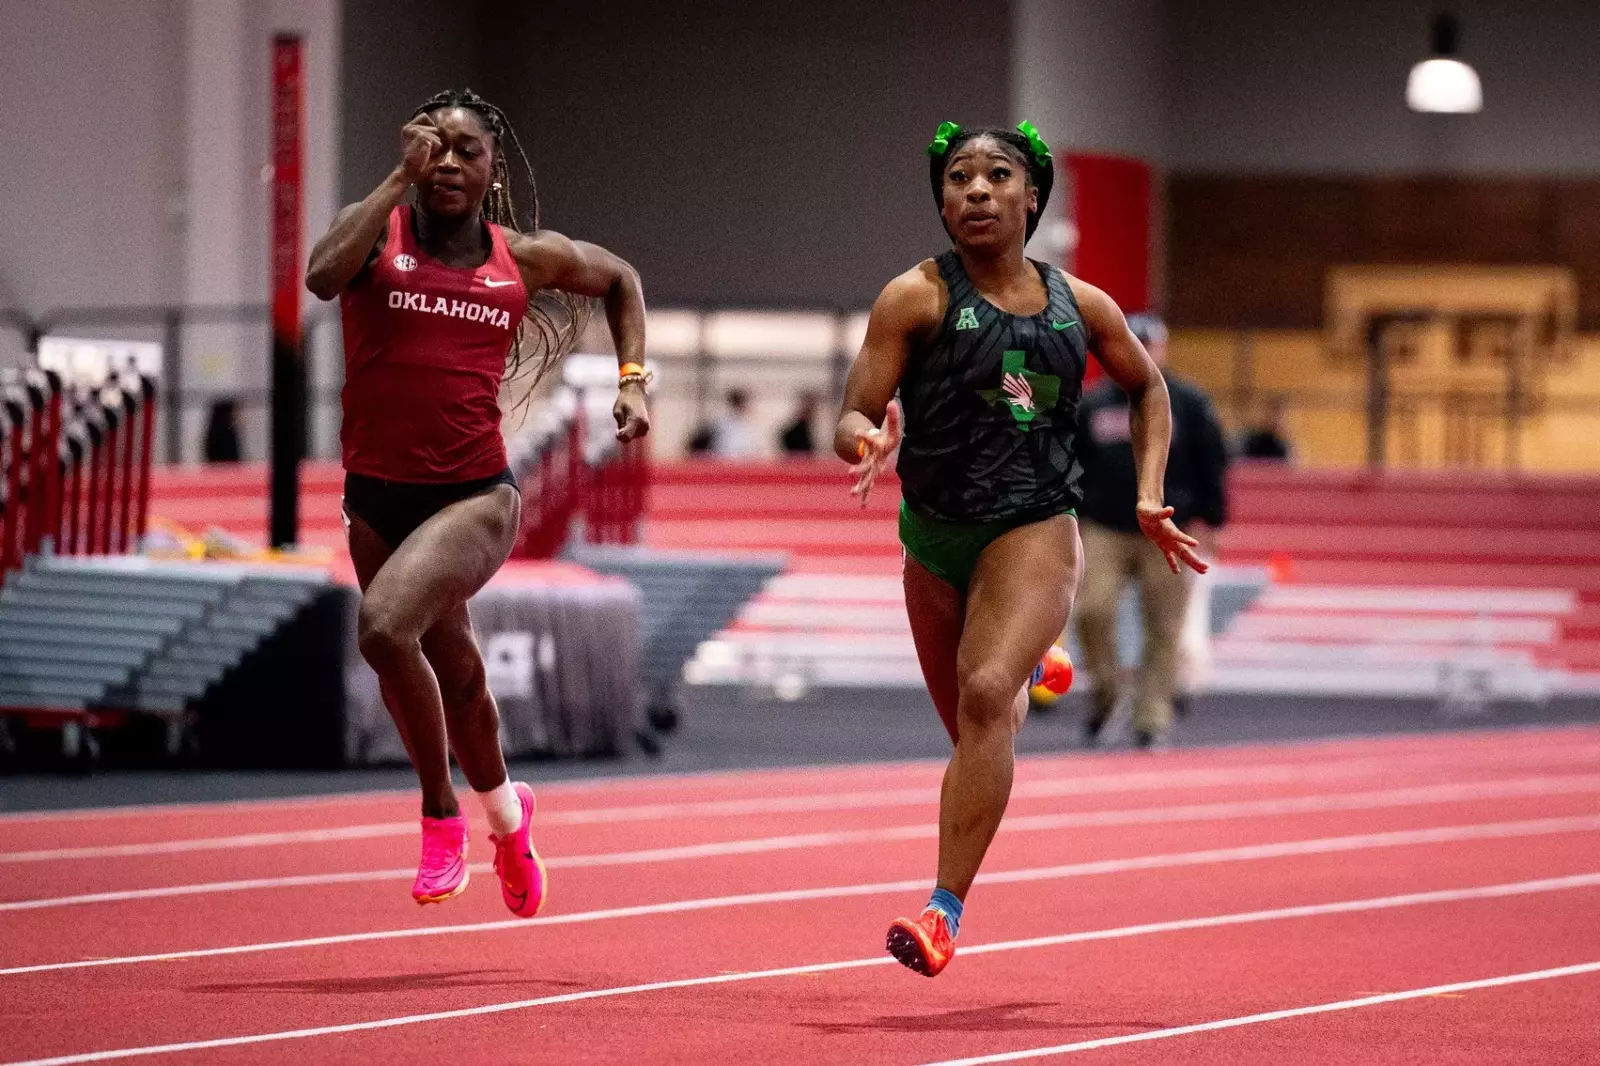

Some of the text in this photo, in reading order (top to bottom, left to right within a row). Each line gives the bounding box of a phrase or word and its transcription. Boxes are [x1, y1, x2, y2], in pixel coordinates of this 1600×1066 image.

[394, 255, 417, 270] SEC
[388, 291, 510, 330] OKLAHOMA
[956, 307, 980, 330] A
